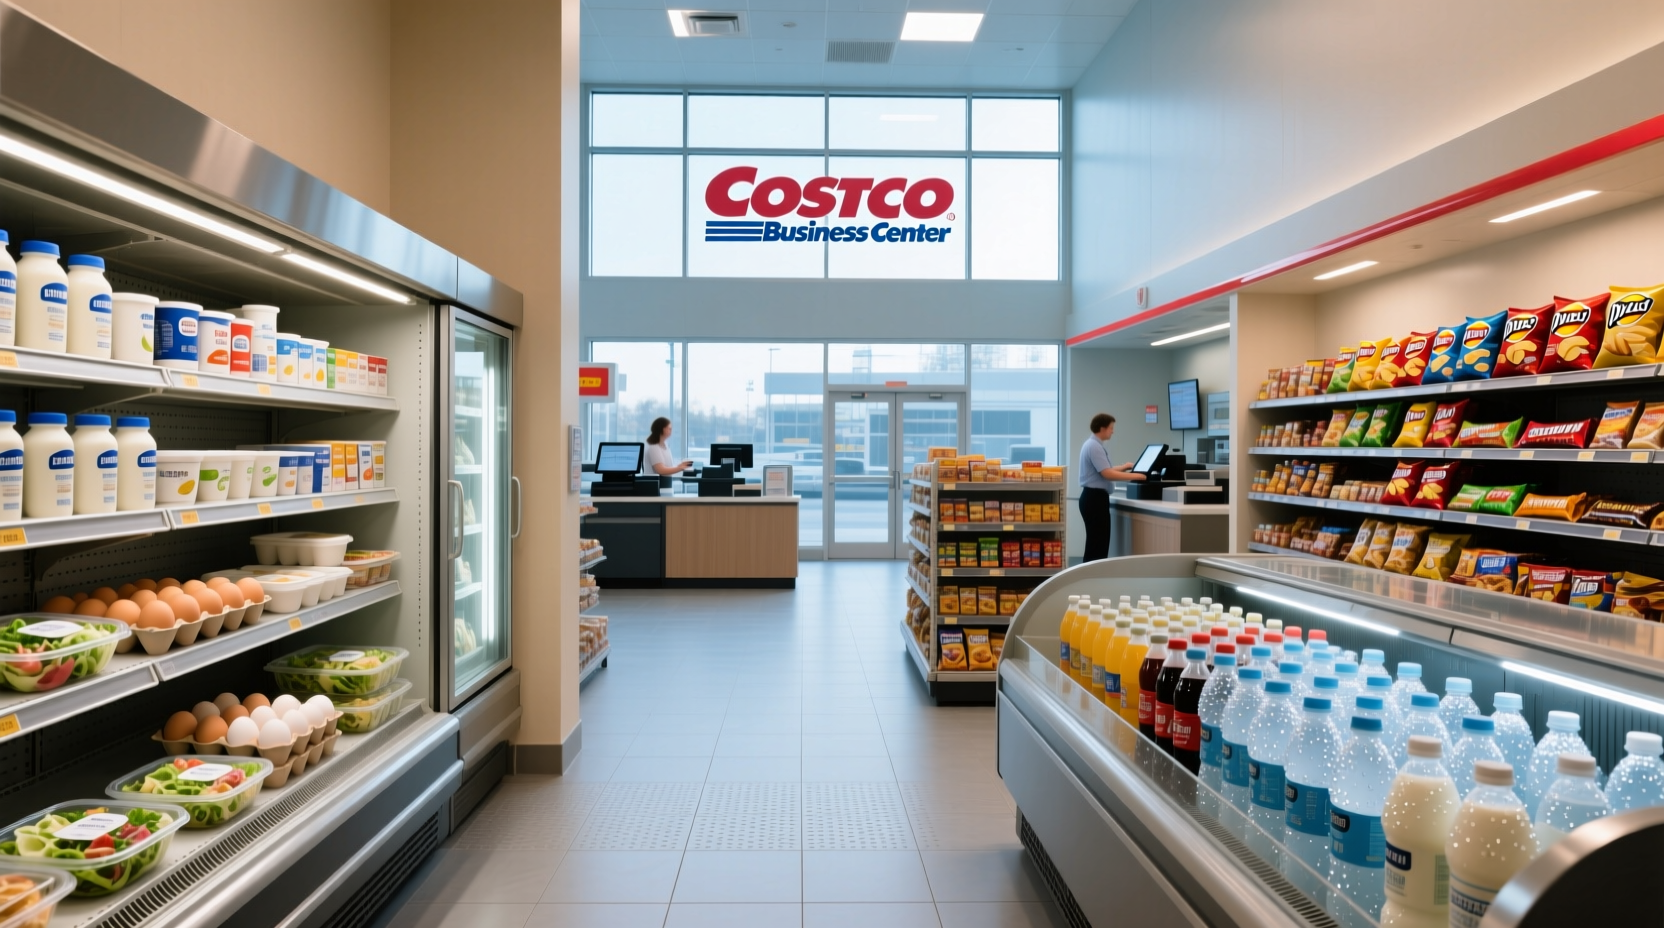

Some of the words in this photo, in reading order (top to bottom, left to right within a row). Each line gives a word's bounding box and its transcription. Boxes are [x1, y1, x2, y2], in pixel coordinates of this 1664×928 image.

[705, 166, 954, 219] COSTCO
[763, 220, 869, 242] Business
[871, 222, 951, 242] Center
